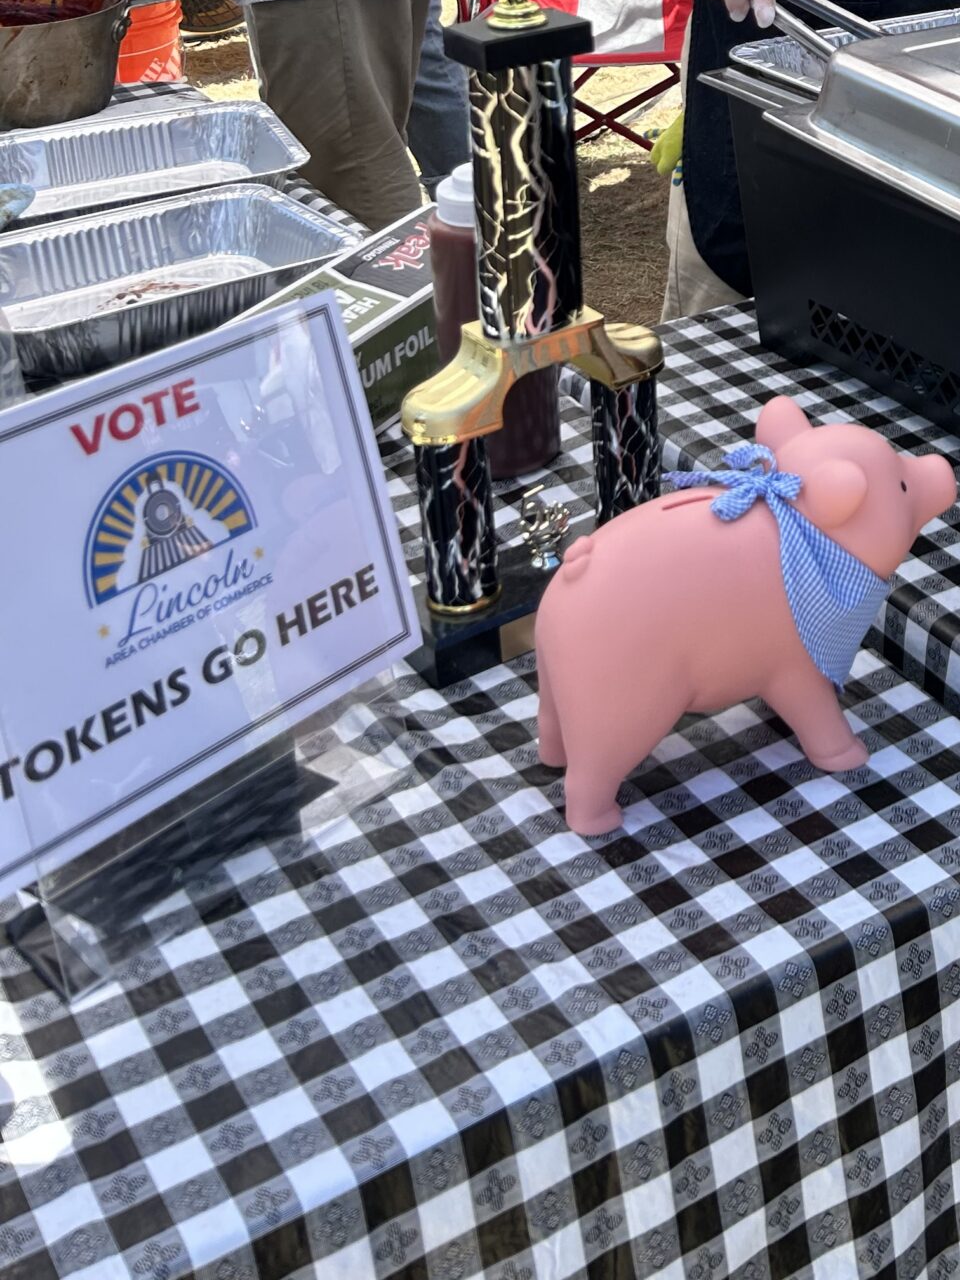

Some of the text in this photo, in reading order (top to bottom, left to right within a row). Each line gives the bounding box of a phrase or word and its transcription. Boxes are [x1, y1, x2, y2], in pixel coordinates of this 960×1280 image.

[378, 221, 431, 271] reak
[394, 325, 434, 367] FOIL
[69, 377, 201, 457] VOTE
[105, 572, 274, 669] AREA CHAMBER OF COMMERCE
[118, 548, 254, 648] Lincoln
[0, 562, 381, 802] TOKENS GO HERE
